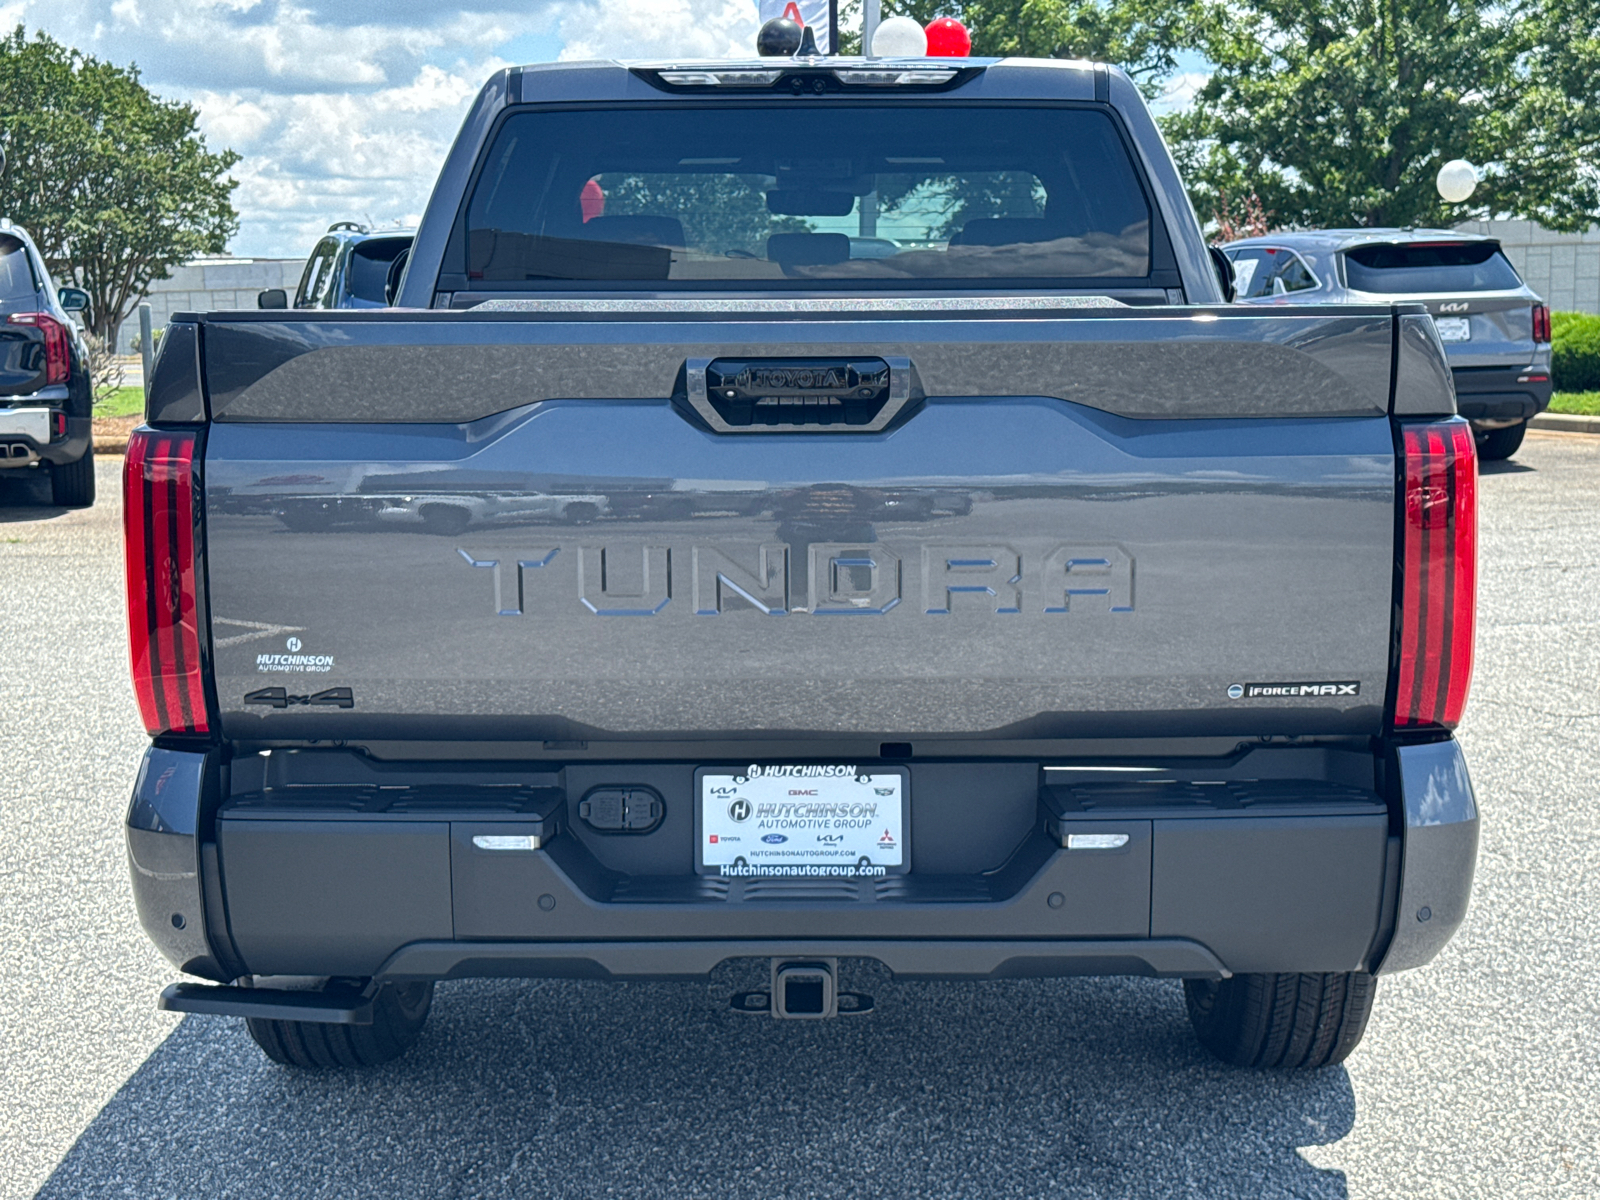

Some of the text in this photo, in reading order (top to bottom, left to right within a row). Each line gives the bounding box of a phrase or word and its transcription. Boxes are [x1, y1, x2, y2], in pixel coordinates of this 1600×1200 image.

[757, 369, 839, 388] TOYOTA
[456, 543, 1136, 616] TUNDRA
[256, 654, 334, 665] HUTCHINSON
[306, 665, 331, 673] GROUP
[764, 765, 857, 777] HUTCHINSON
[756, 803, 877, 818] HUTCHINSON
[758, 819, 872, 829] AUTOMOTIVE GROUP
[720, 864, 886, 877] Hutchinsonautogroup.com
